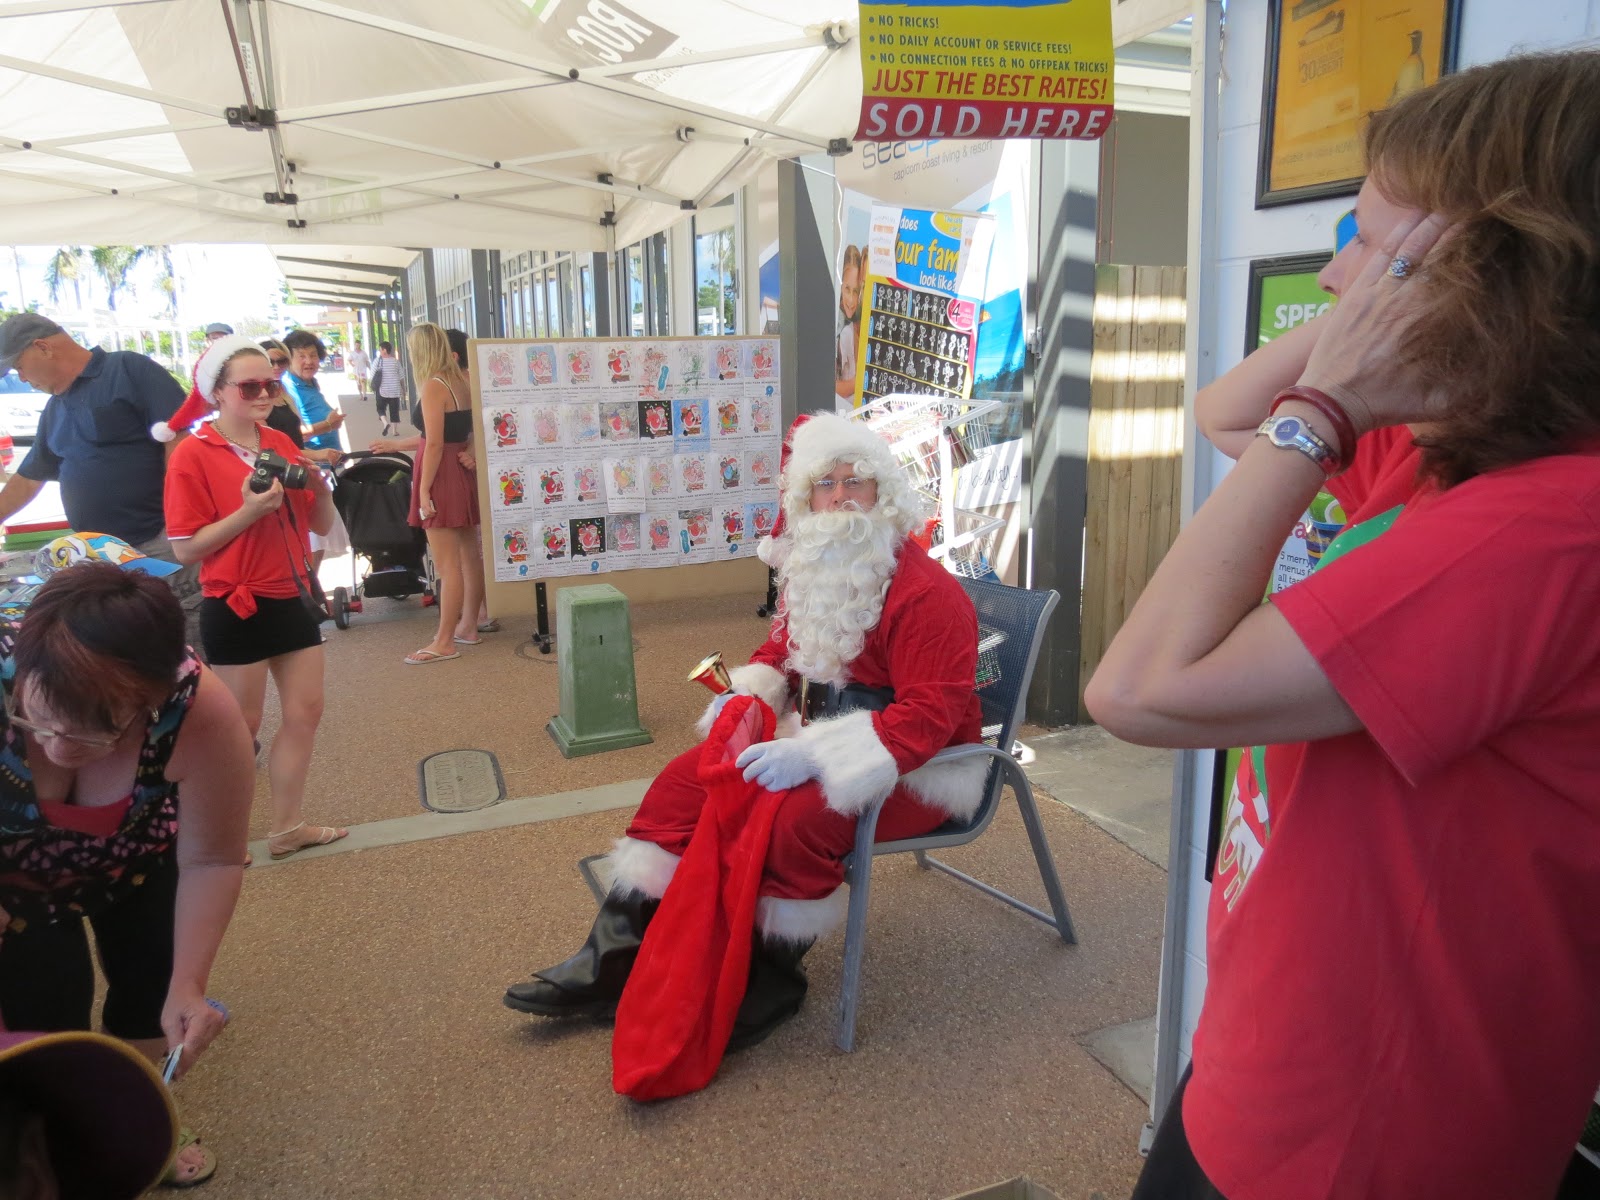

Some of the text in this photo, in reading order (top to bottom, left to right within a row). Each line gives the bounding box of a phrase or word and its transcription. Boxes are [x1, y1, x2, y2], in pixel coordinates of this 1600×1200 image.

[879, 15, 939, 28] NO TRICKS!
[880, 34, 1072, 54] NO DAILY ACCOUNT OR SERVICE FEES!
[880, 53, 1108, 73] NO CONNECTION FEES & NO OFFPEAK TRICKS!
[872, 69, 1108, 100] JUST THE BEST RATES!
[865, 103, 1106, 138] SOLD HERE
[970, 140, 993, 155] resort
[896, 237, 924, 266] our
[920, 271, 936, 288] look
[1286, 554, 1310, 568] merry
[1278, 564, 1306, 576] menus
[1278, 574, 1287, 582] all
